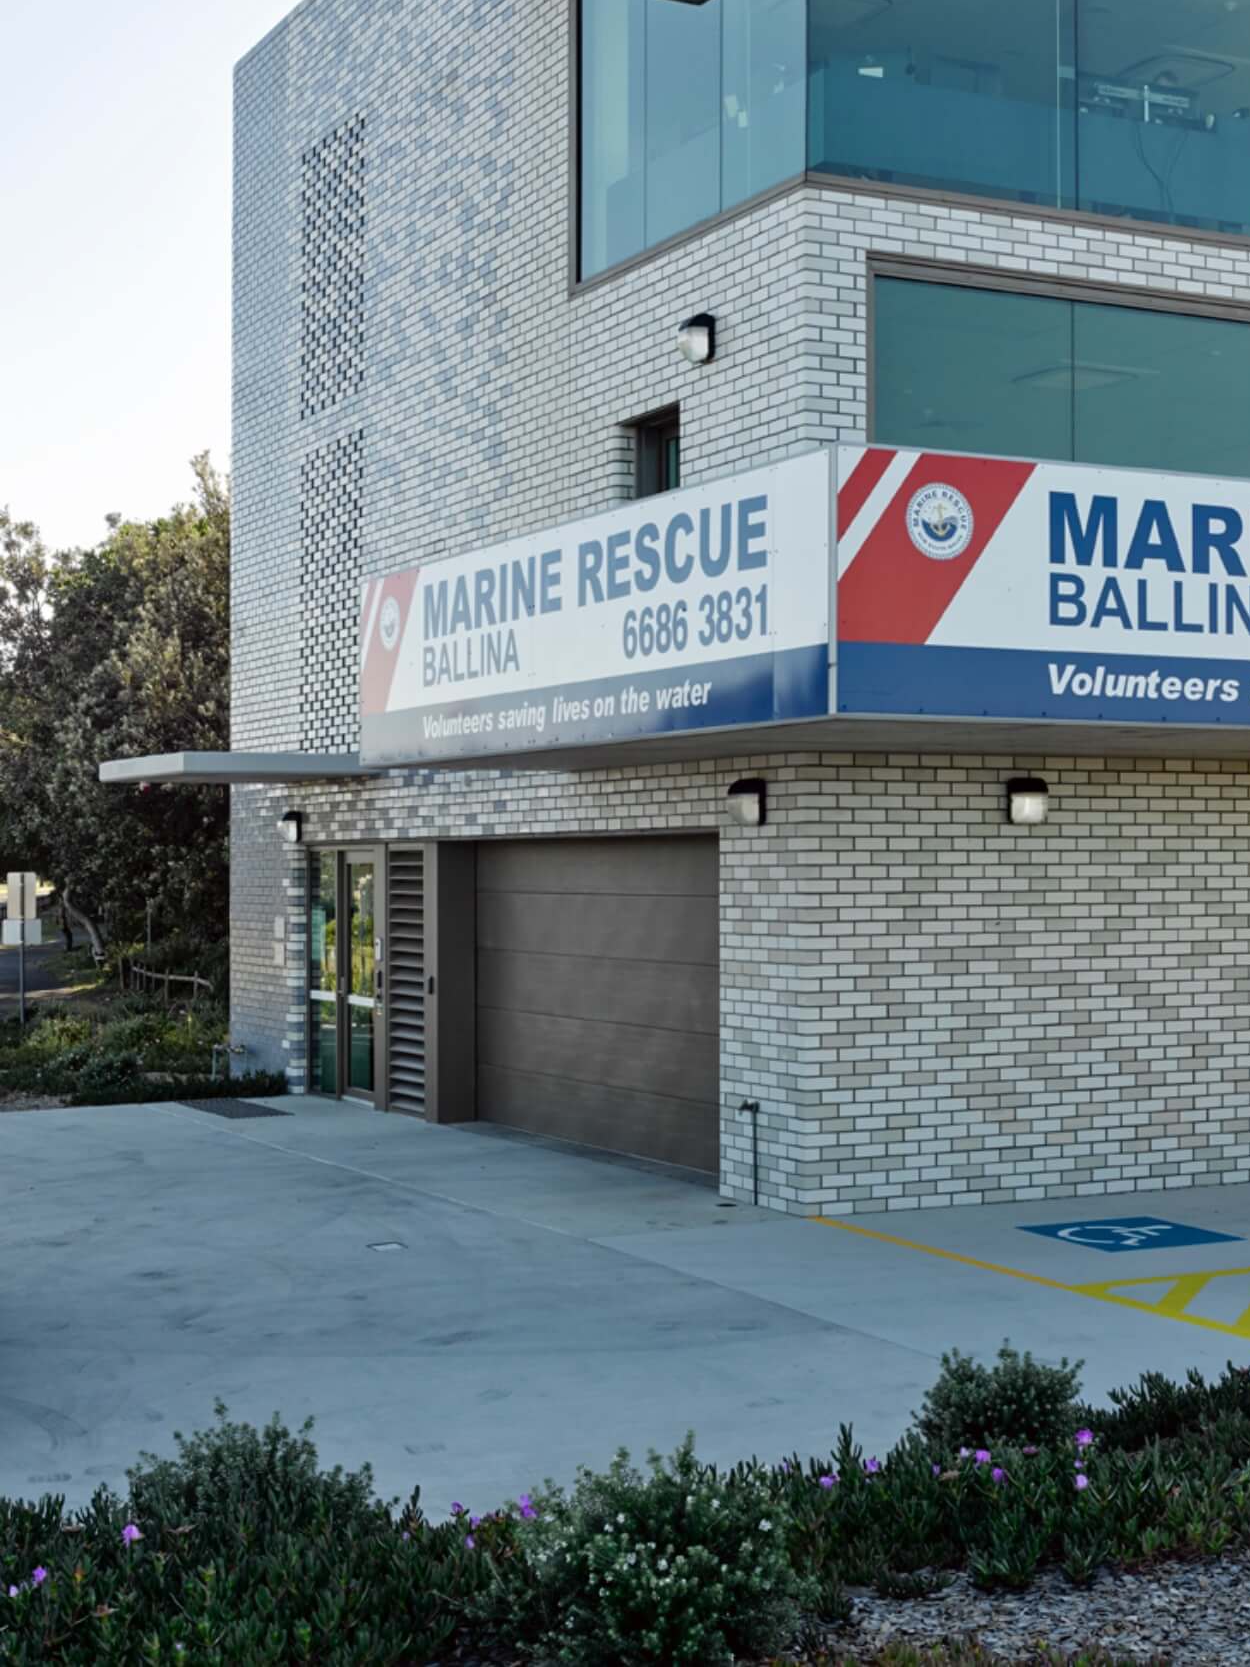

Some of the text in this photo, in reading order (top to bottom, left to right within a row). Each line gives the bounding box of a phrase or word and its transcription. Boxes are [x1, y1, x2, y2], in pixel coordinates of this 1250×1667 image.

[423, 494, 768, 641] MARINE RESCUE
[623, 584, 768, 660] 6686 3831
[422, 629, 520, 688] BALLINA
[1047, 663, 1240, 703] Volunteers
[422, 679, 712, 740] Volunteers saving lives on the water
